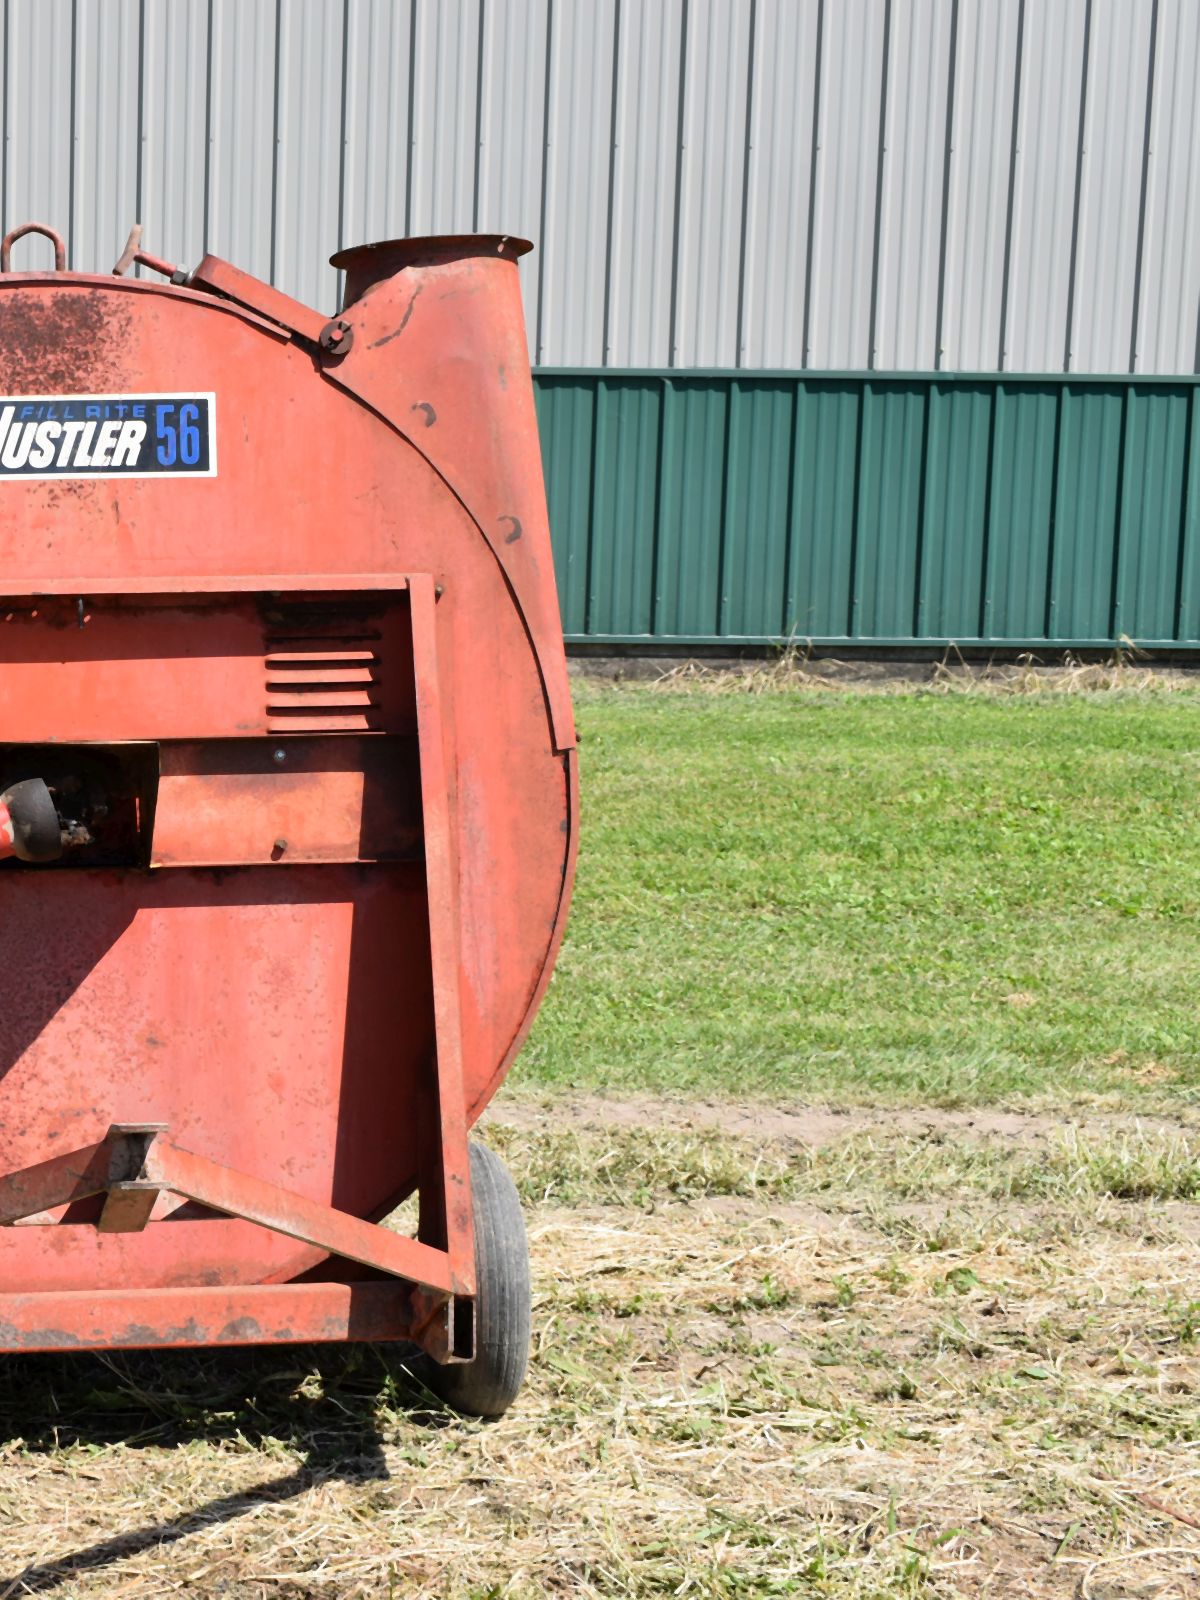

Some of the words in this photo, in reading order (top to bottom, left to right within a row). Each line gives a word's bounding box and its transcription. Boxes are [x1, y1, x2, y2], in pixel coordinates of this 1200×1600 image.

[20, 405, 75, 420] FILL
[85, 404, 146, 419] RITE
[156, 403, 200, 466] 56
